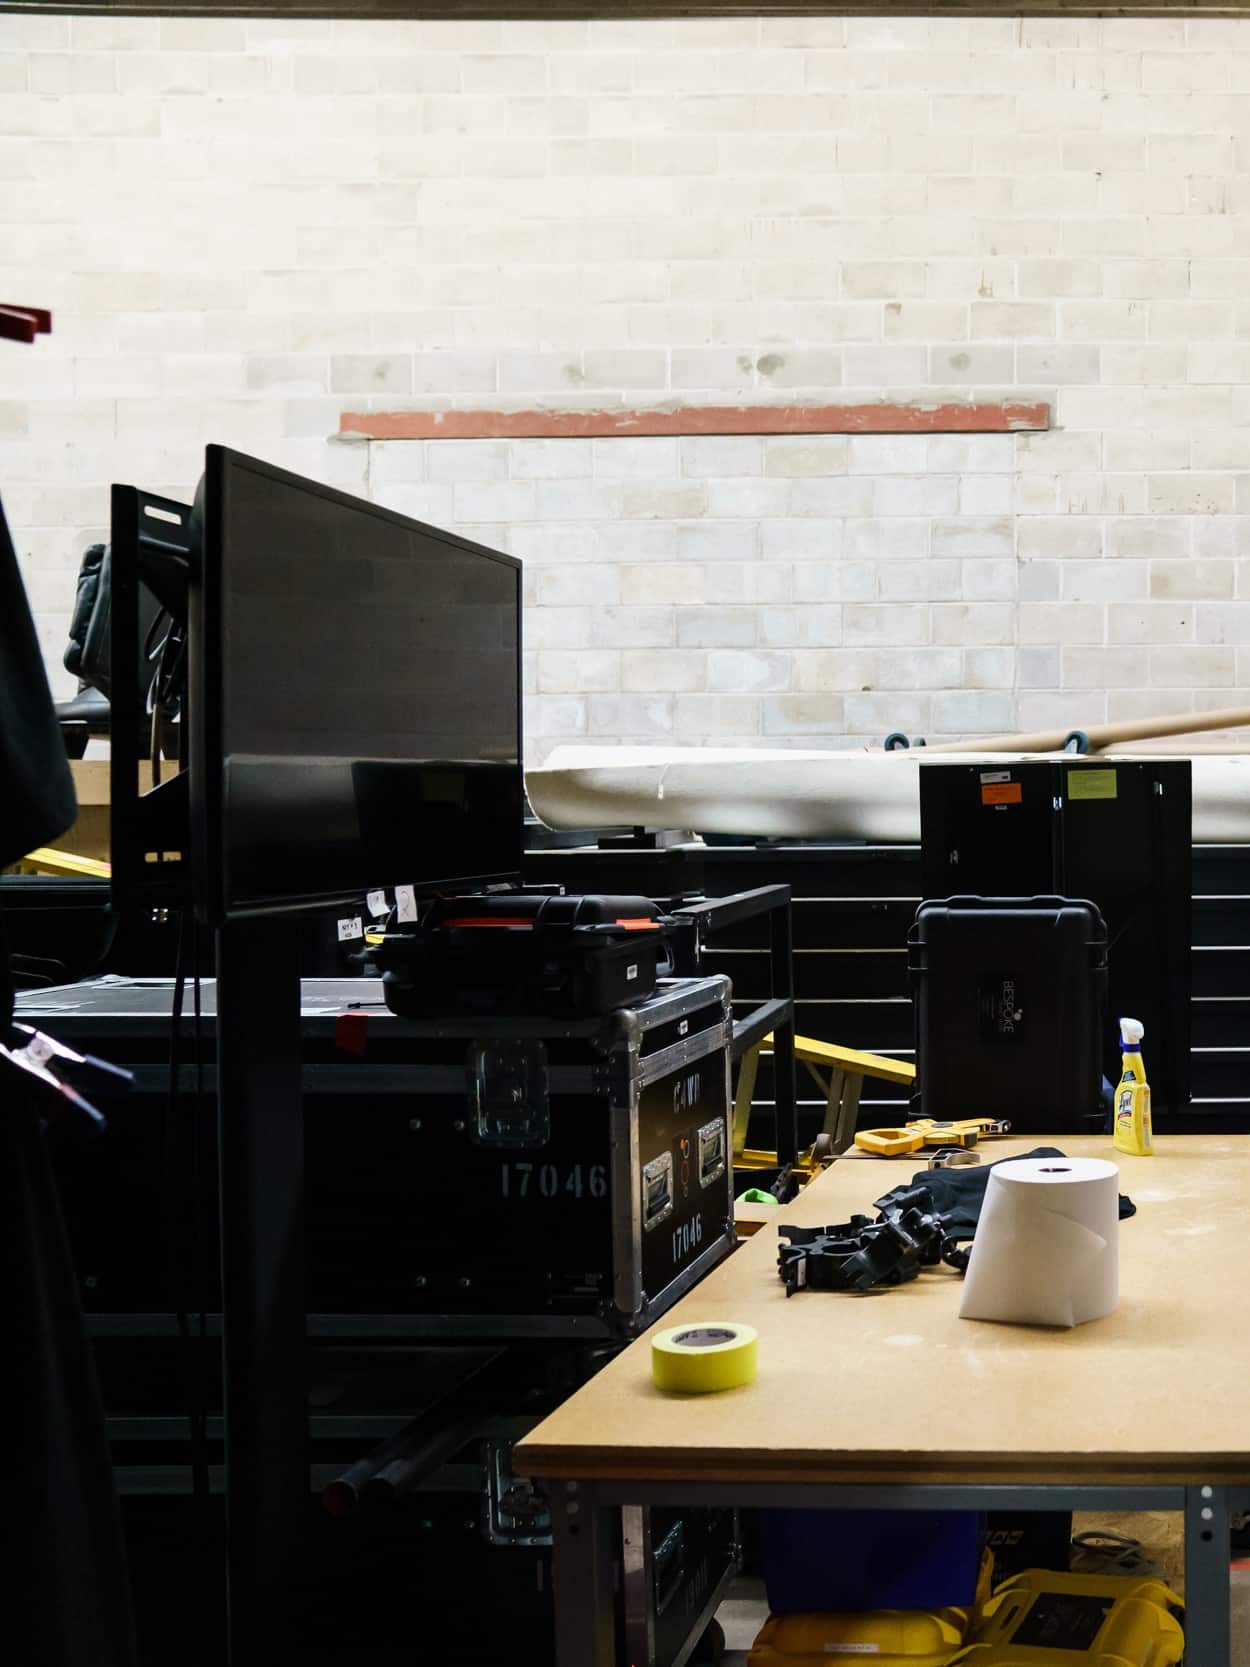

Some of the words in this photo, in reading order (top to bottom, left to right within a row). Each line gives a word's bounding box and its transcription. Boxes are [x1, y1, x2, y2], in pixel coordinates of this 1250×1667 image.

[1002, 980, 1015, 1033] BESPOKE
[501, 1162, 608, 1199] 17046
[672, 1212, 702, 1263] 17046
